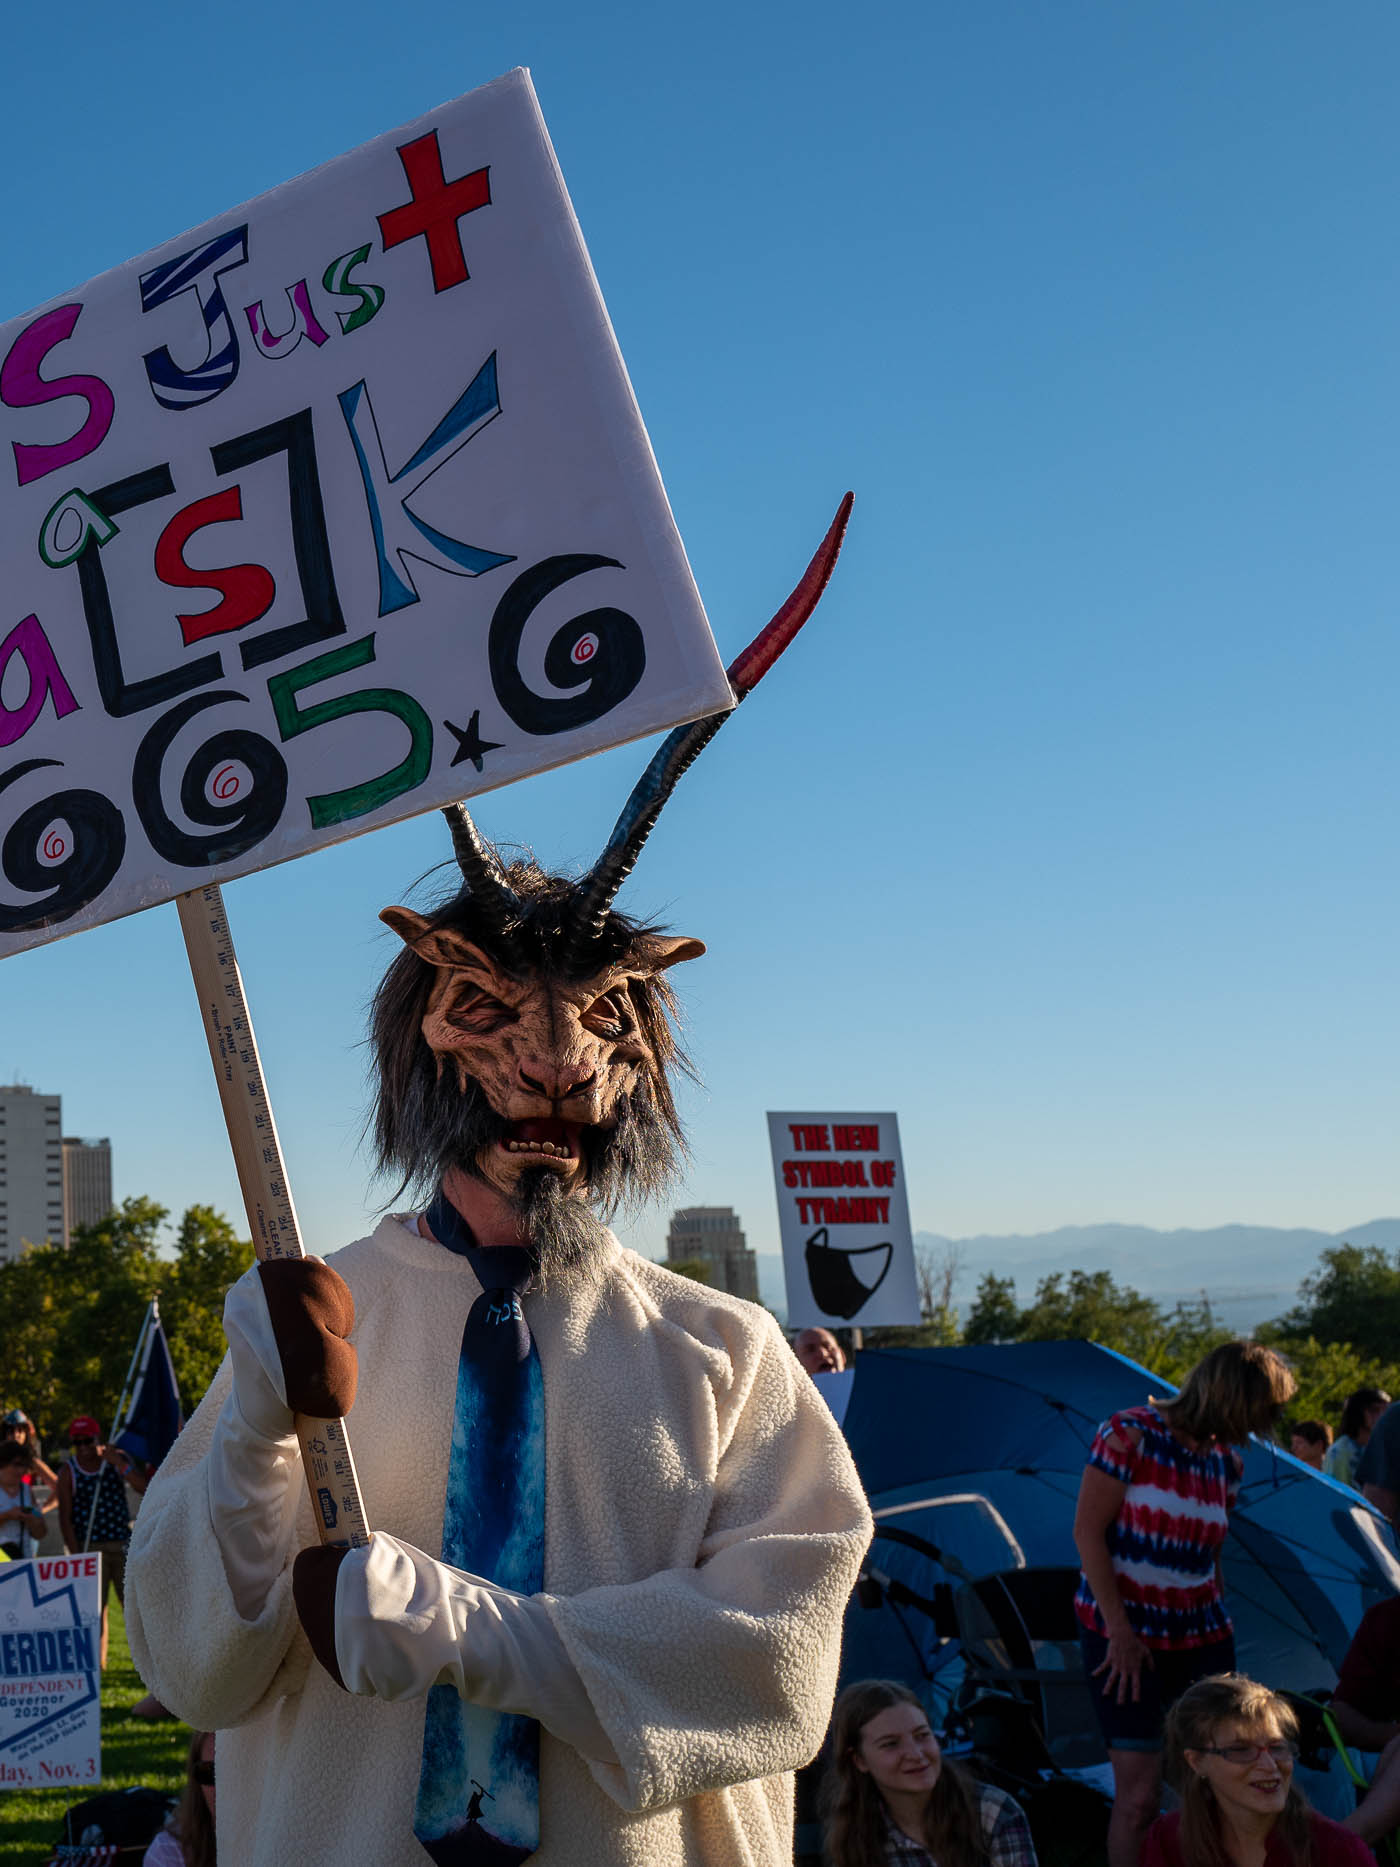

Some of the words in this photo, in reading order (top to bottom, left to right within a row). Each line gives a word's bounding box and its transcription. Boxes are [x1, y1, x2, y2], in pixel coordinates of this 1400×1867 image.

[210, 920, 220, 933] 15
[218, 952, 227, 965] 16
[225, 984, 235, 997] 17
[224, 1025, 237, 1054] PAINT
[240, 1049, 249, 1063] 19
[248, 1082, 257, 1096] 20
[255, 1115, 265, 1128] 21
[788, 1124, 831, 1152] THE
[832, 1124, 879, 1152] NEW
[263, 1148, 272, 1163] 22
[782, 1160, 869, 1188] SYMBOL
[870, 1160, 896, 1188] OF
[270, 1182, 280, 1196] 23
[795, 1196, 890, 1224] TYRANNY
[278, 1215, 288, 1231] 24
[268, 1220, 282, 1255] CLEAN
[38, 1557, 97, 1581] VOTE
[0, 1694, 65, 1707] Governor
[14, 1706, 49, 1719] 2020
[40, 1760, 80, 1778] Nov.
[85, 1757, 97, 1778] 3
